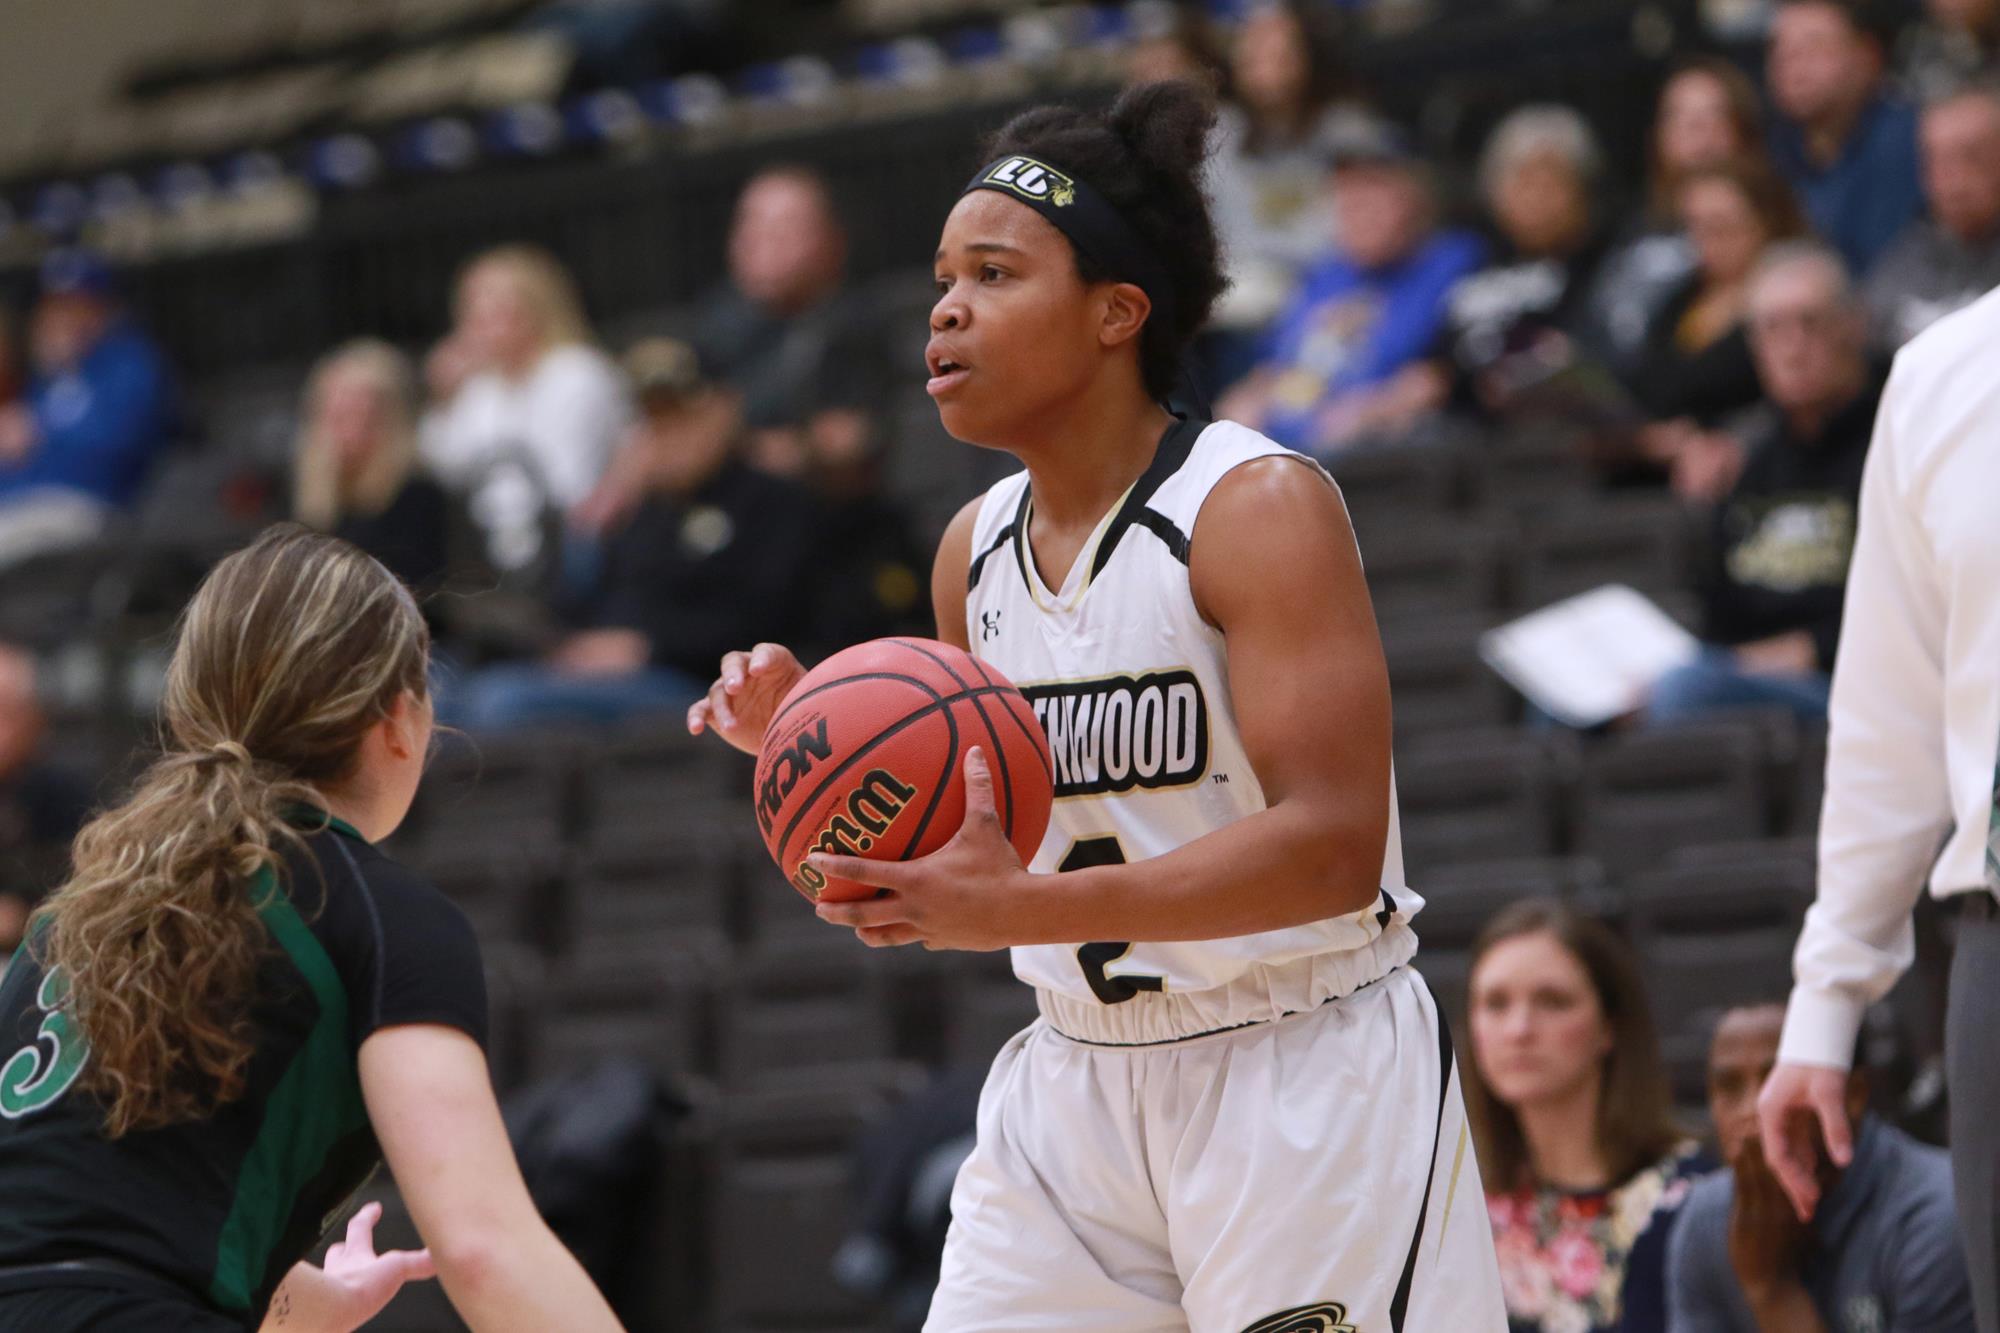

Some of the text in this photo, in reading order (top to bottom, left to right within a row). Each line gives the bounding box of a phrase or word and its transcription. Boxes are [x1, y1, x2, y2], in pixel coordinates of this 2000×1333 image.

[987, 157, 1064, 198] LU
[758, 716, 832, 838] NCAA
[1033, 681, 1198, 786] NWOOD
[1212, 773, 1229, 784] TM
[793, 768, 918, 899] Wilon
